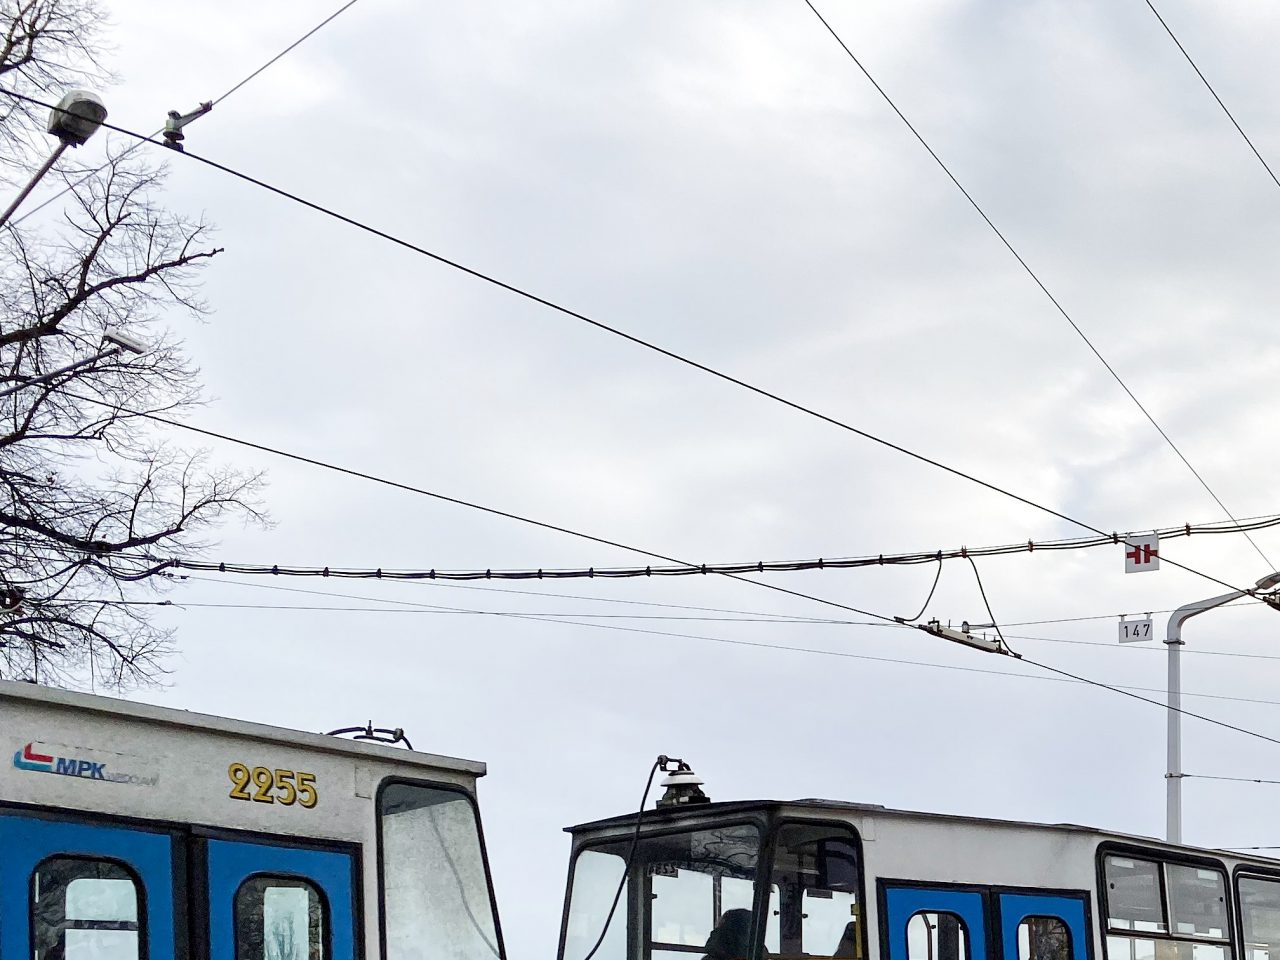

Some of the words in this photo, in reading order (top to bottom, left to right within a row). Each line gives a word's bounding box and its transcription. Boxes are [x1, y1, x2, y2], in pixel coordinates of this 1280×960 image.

[1123, 623, 1150, 639] 147
[56, 756, 106, 780] MPK
[227, 762, 318, 809] 2255
